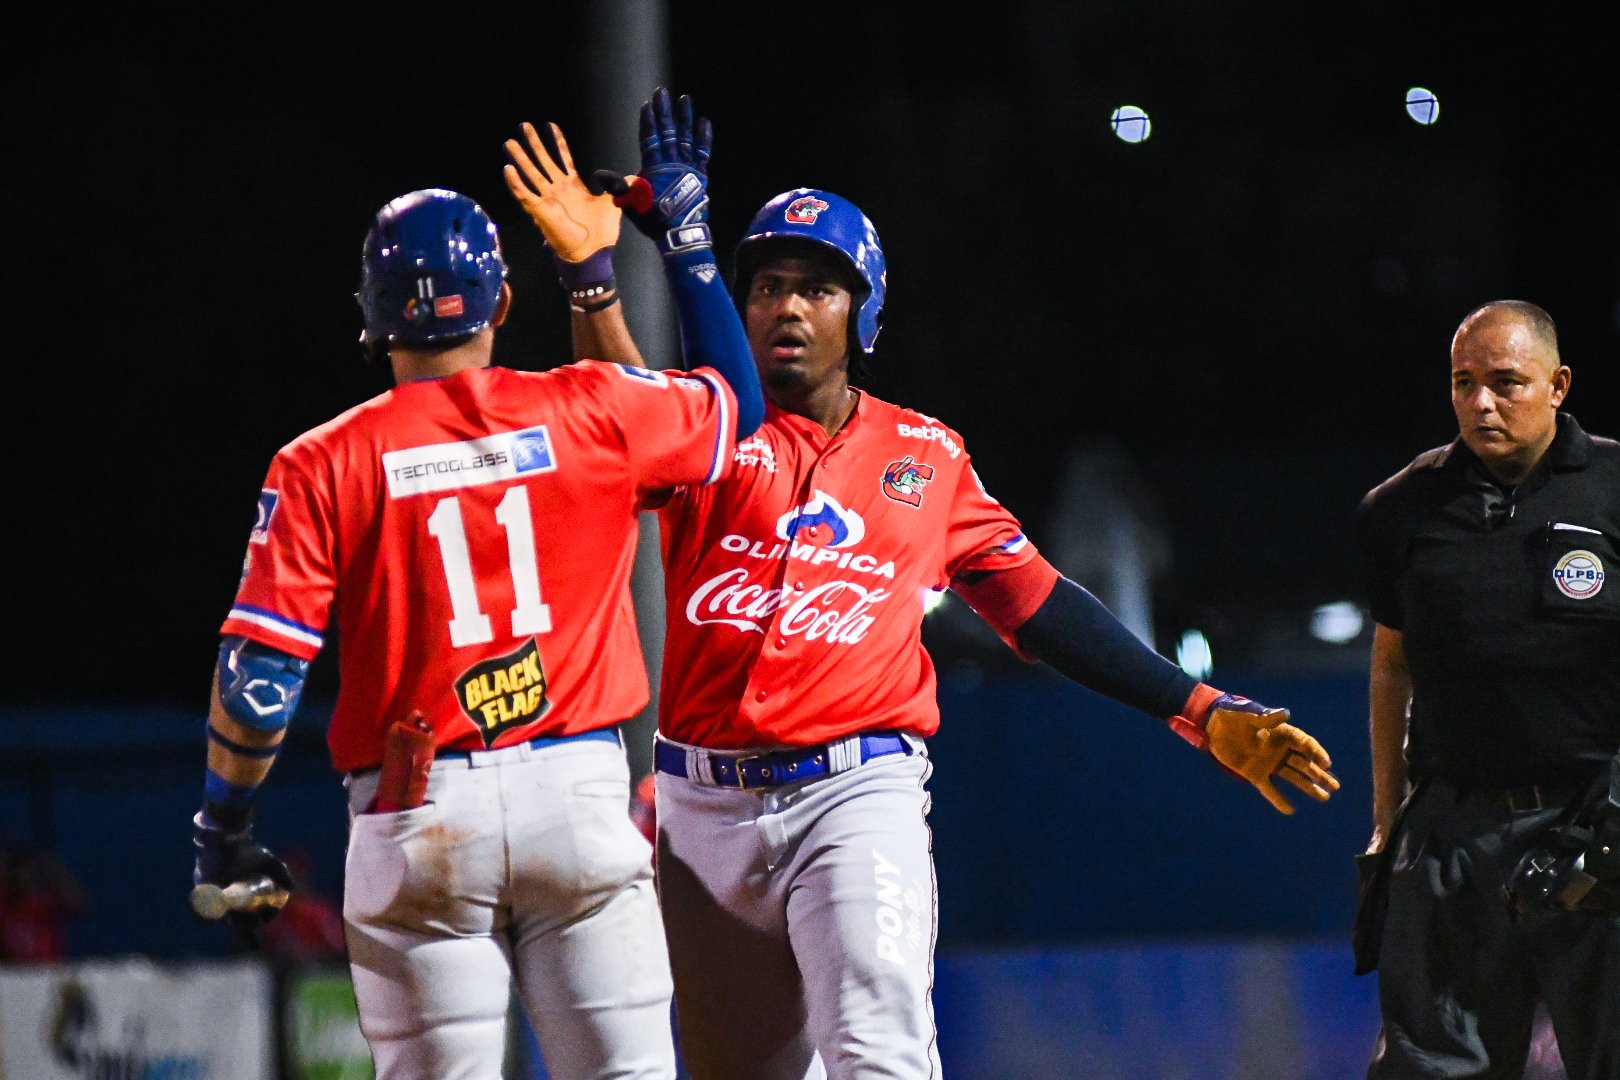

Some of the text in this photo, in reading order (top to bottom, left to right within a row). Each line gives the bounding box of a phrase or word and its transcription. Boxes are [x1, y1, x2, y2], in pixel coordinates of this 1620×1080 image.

[417, 277, 433, 298] 11
[897, 423, 961, 459] BetPlay
[427, 485, 553, 648] 11
[720, 534, 895, 579] OLIMPICA
[1566, 569, 1595, 580] LPB
[465, 650, 542, 711] BLACK
[480, 684, 543, 729] FLAG
[872, 848, 905, 966] PONY
